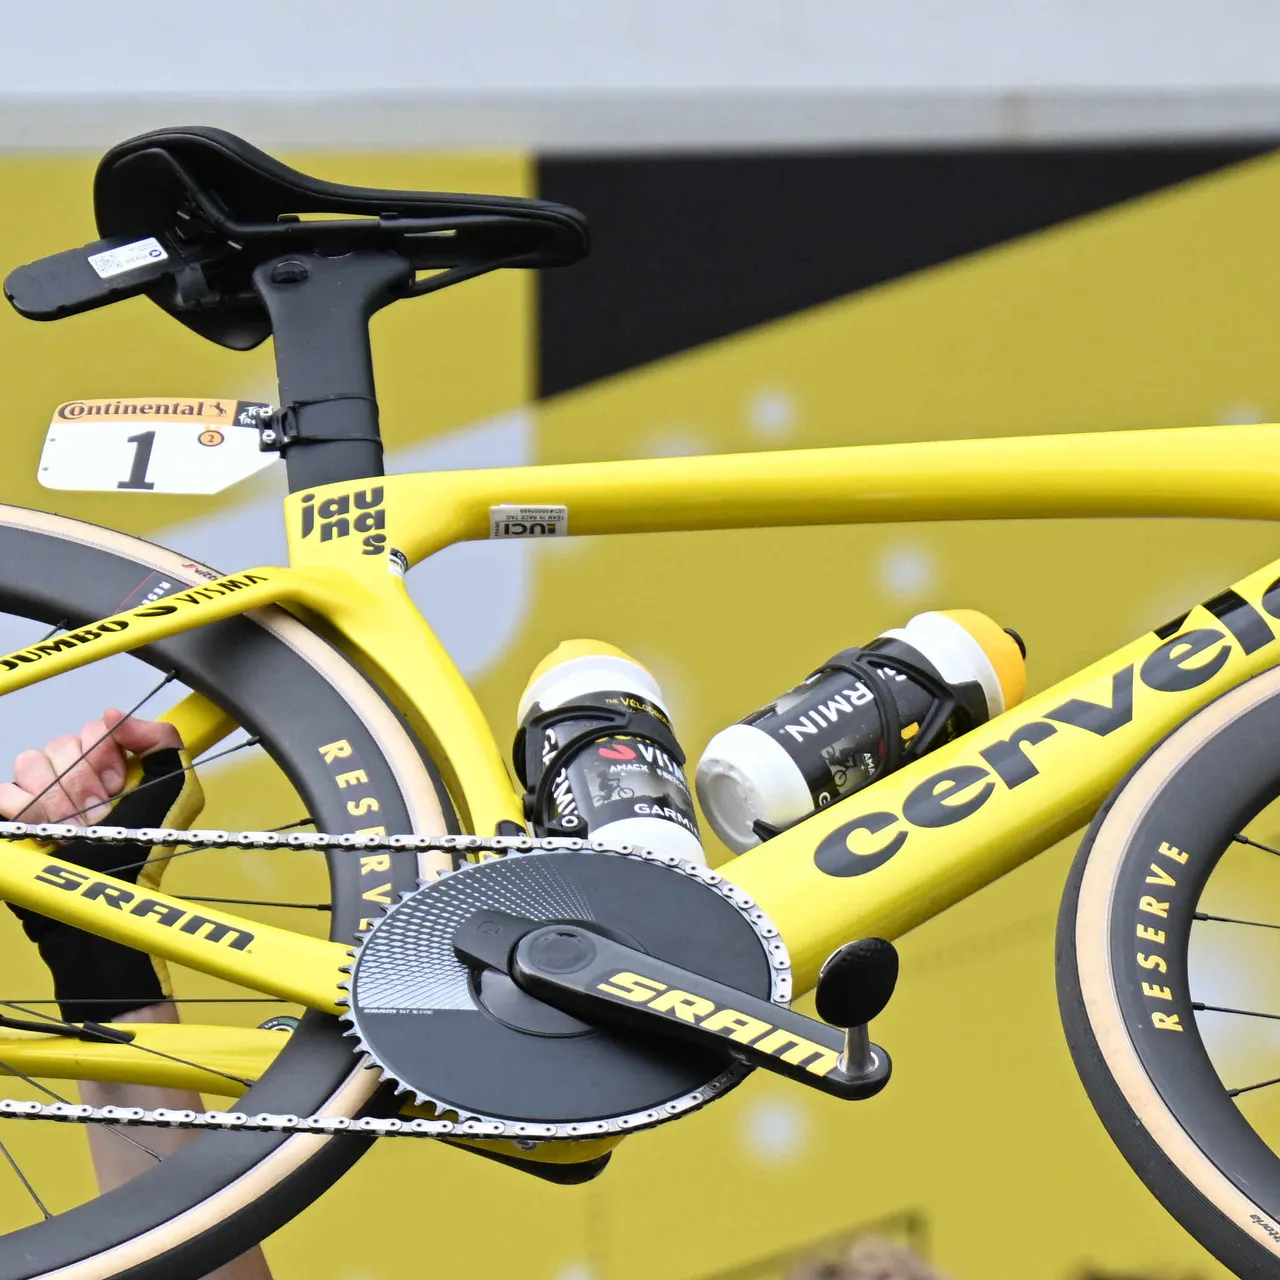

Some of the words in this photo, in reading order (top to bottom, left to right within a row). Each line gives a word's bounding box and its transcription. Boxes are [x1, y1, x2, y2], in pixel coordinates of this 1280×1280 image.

[57, 401, 204, 421] Continental
[207, 434, 215, 443] 2
[117, 430, 156, 490] 1
[503, 522, 546, 535] UCI
[1, 619, 129, 672] JUMBO
[174, 574, 269, 606] VISMA
[34, 862, 256, 952] SRAM
[1131, 841, 1190, 1033] RESERVE
[596, 971, 841, 1079] SRAM
